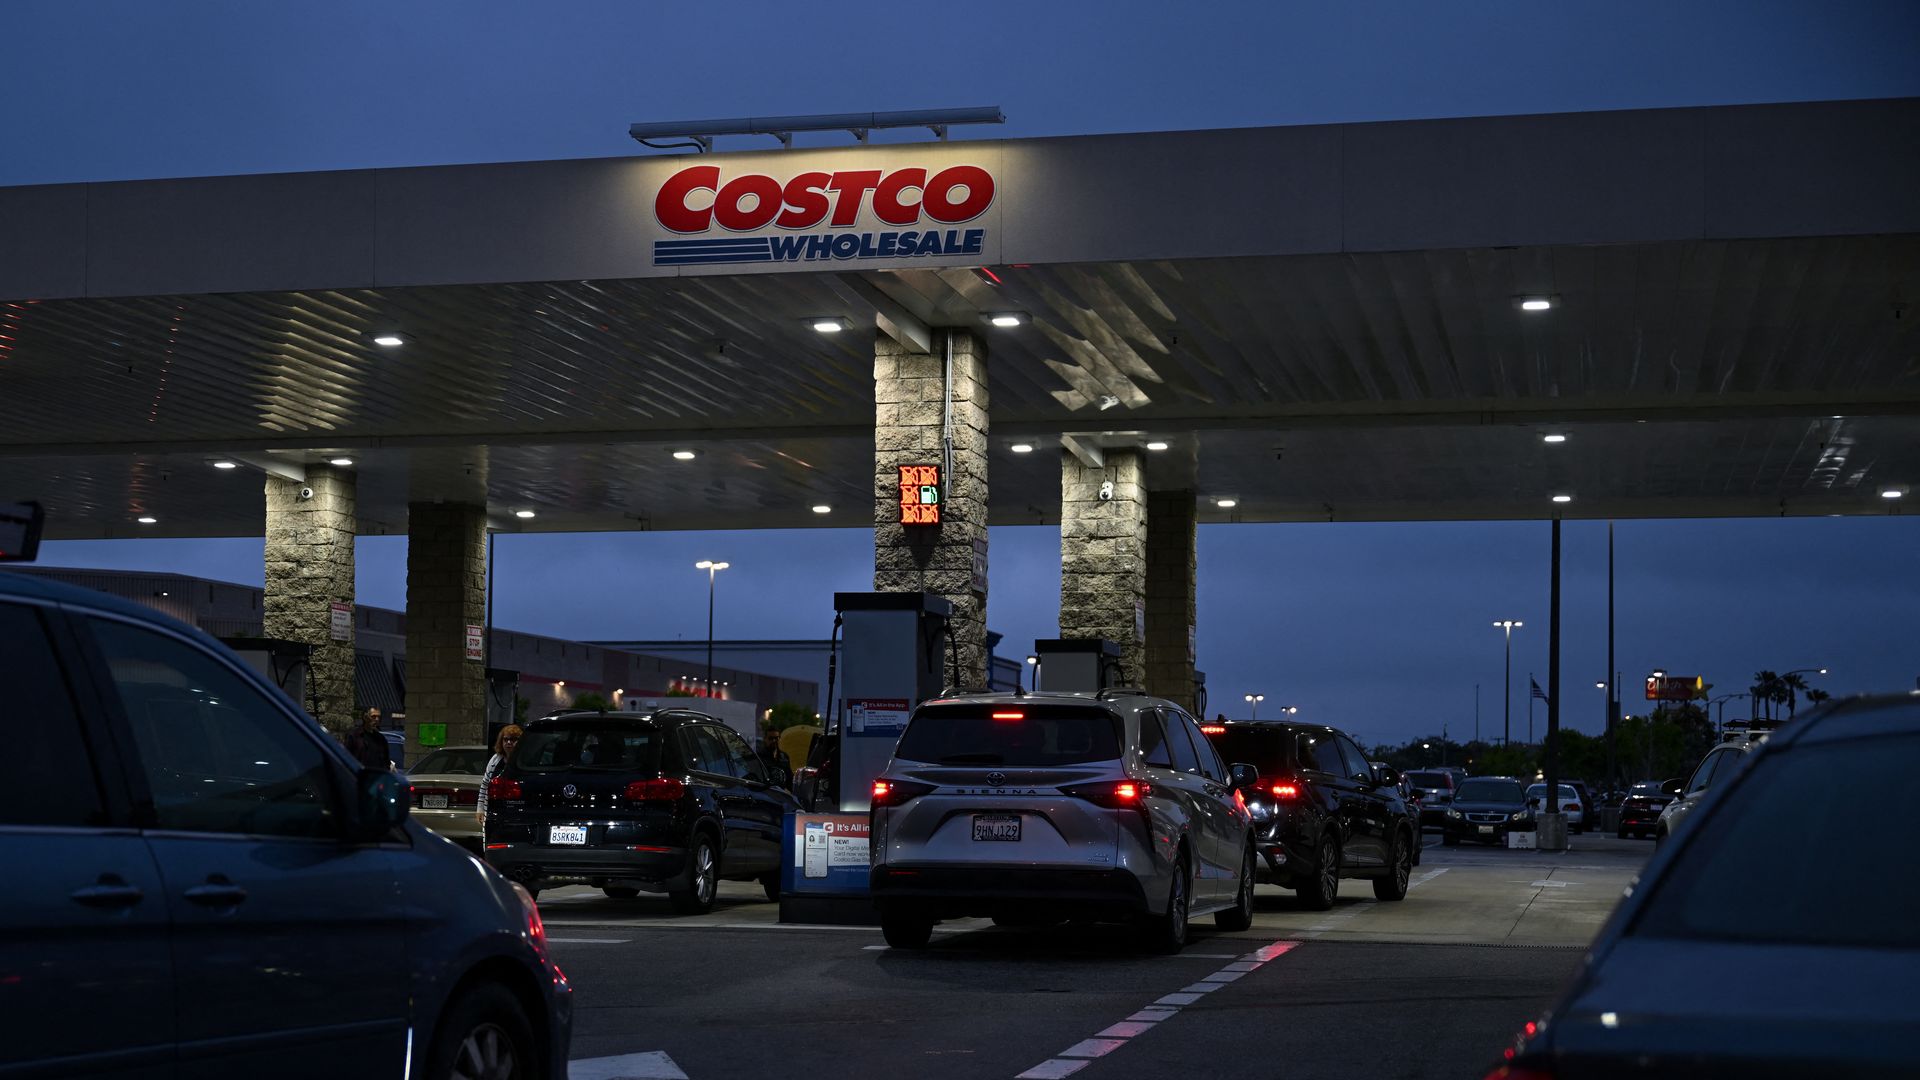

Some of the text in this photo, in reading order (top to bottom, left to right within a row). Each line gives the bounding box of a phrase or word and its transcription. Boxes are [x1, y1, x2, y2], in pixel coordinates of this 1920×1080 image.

[654, 165, 996, 233] COSTCO
[769, 229, 985, 261] WHOLESALE
[837, 823, 870, 832] It's All in
[976, 825, 1018, 837] 9HNJ129
[551, 832, 584, 843] 8SRK841
